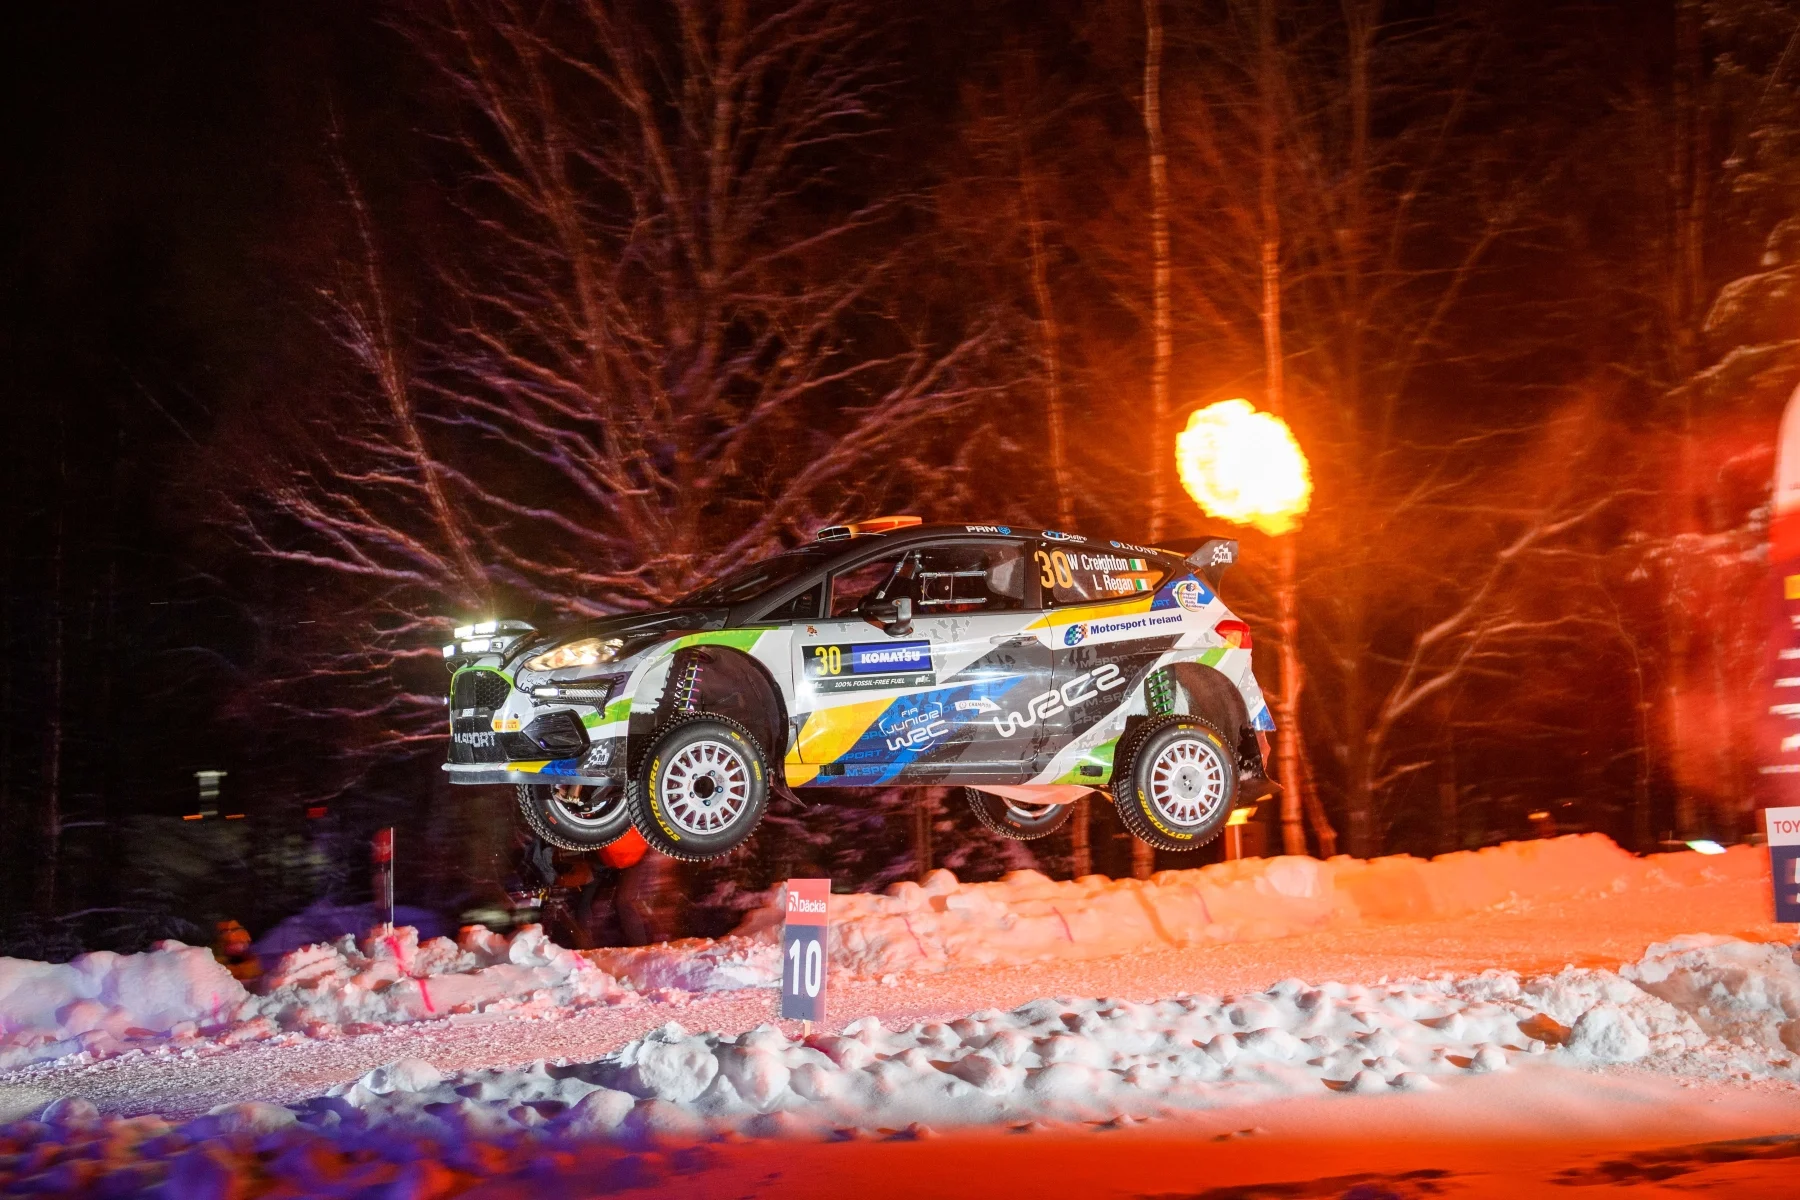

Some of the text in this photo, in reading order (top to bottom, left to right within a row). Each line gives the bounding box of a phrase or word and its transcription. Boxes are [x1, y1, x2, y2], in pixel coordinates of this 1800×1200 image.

[1120, 542, 1158, 556] LYONS
[1034, 550, 1073, 589] 30
[1065, 553, 1129, 574] W Creighton
[1092, 573, 1135, 595] L Regan
[1090, 614, 1183, 635] Motorsport Ireland
[815, 645, 841, 676] 30
[861, 648, 920, 664] KOMATSU
[834, 680, 852, 688] 100%
[852, 678, 890, 687] FOSSIL-FREE
[992, 663, 1126, 737] WRC2
[886, 711, 940, 734] JUNIOR
[901, 707, 919, 718] FIA
[886, 719, 949, 751] WRC
[648, 756, 681, 843] SOTTOZERO
[1137, 788, 1194, 840] SOTTOZERO
[799, 899, 827, 913] Däckia
[788, 938, 822, 998] 10
